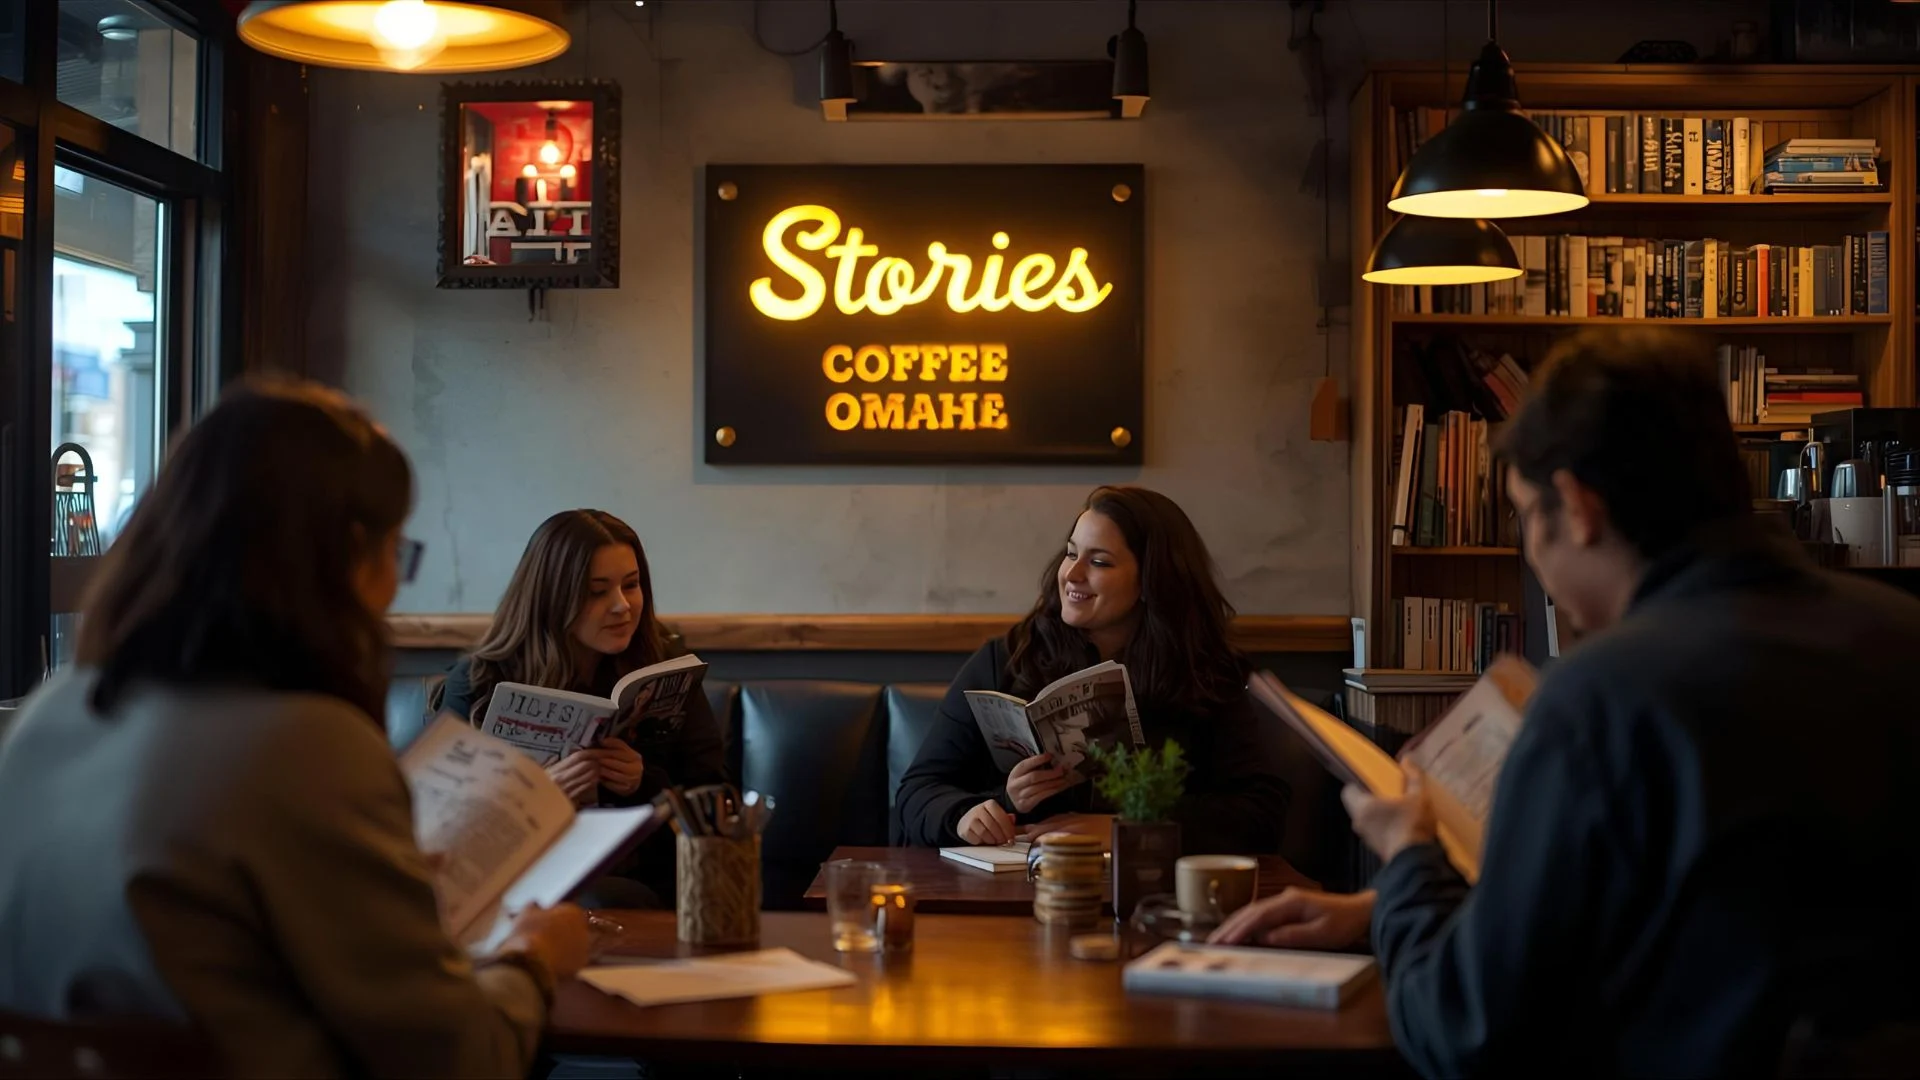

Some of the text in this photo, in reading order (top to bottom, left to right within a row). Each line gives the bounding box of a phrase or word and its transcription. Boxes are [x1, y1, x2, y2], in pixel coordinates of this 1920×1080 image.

[749, 204, 1113, 321] Stories
[822, 344, 1008, 383] COFFEE
[825, 393, 1008, 431] OMAHE
